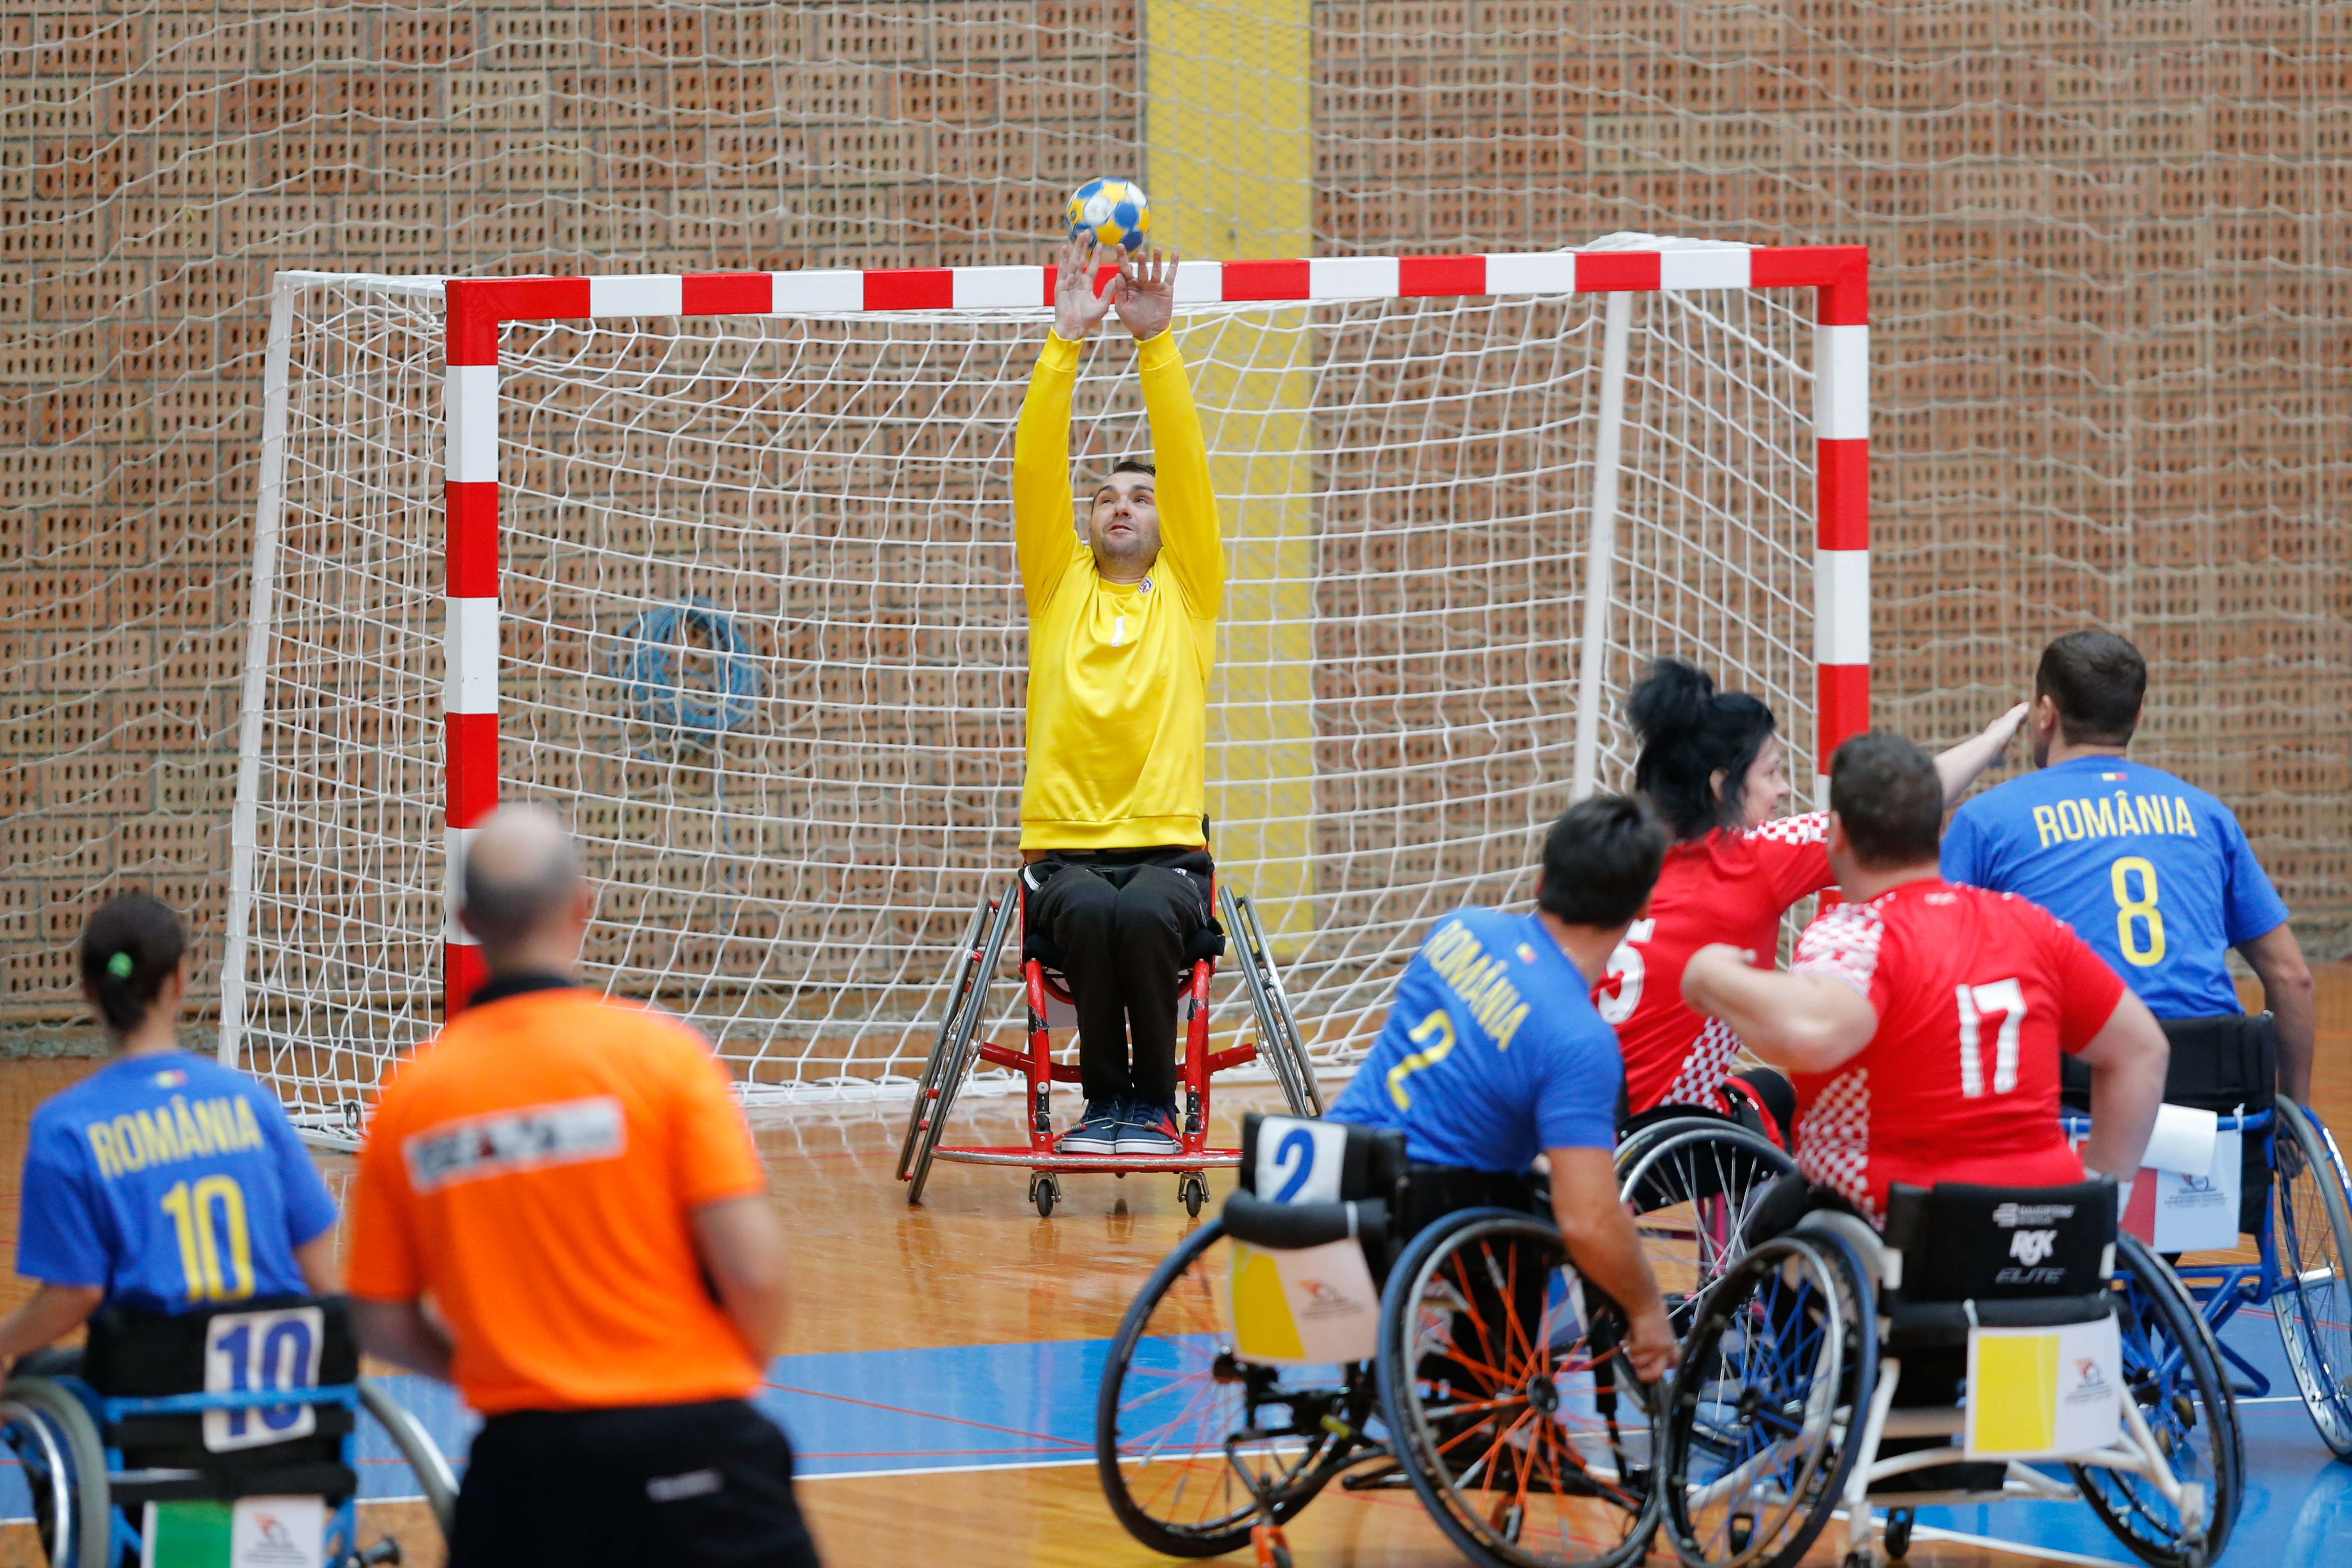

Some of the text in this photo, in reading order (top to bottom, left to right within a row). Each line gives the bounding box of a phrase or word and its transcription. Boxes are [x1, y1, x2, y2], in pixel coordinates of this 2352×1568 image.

[2032, 790, 2196, 848] ROMÂNIA
[2111, 856, 2166, 967] 8
[1422, 919, 1531, 1052] ROMÂNIA
[1599, 918, 1656, 1024] 5
[1386, 1008, 1456, 1112] 2
[1956, 977, 2027, 1098] 17
[88, 1095, 263, 1178] ROMÂNIA
[1275, 1128, 1315, 1203] 2
[162, 1174, 255, 1303] 10
[217, 1319, 312, 1436] 10
